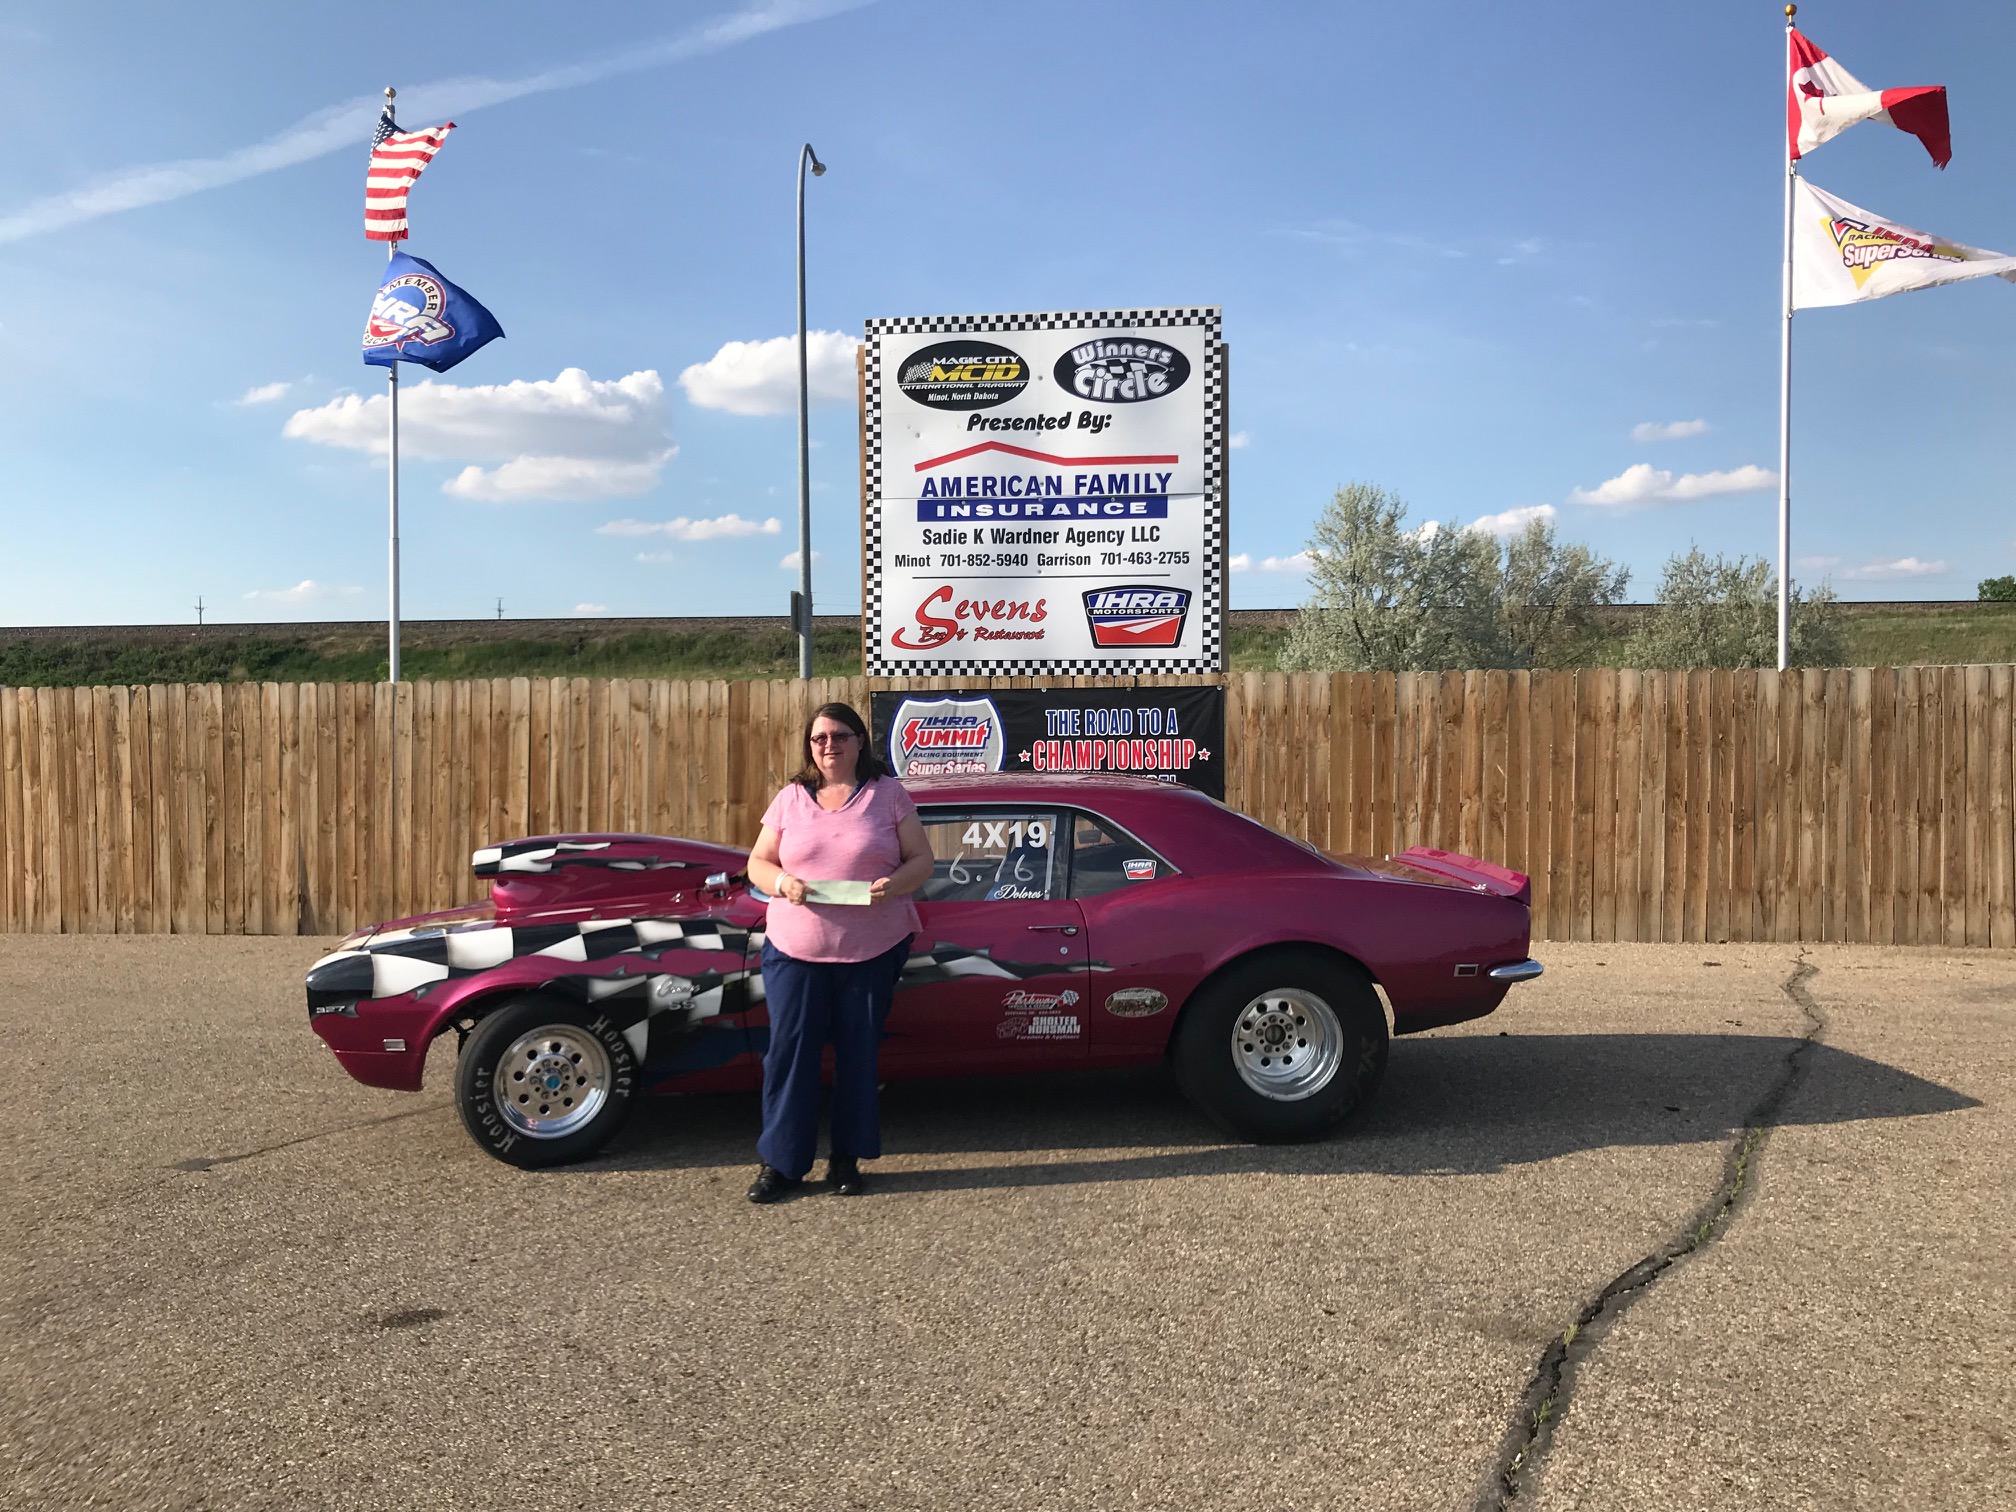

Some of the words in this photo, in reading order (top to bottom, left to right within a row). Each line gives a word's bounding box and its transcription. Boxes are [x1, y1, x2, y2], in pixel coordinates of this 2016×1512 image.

[389, 277, 438, 311] MEMBER
[932, 357, 983, 365] MAGIC
[985, 356, 1019, 365] CITY
[1071, 340, 1174, 365] Winners
[929, 364, 1021, 382] MCID
[1074, 367, 1171, 400] Circle
[901, 383, 974, 391] INTERNATIONAL
[927, 393, 949, 402] Minot,
[951, 392, 972, 401] North
[973, 392, 999, 400] Dakota
[967, 412, 1072, 432] Presented
[1077, 411, 1112, 434] By:
[921, 475, 1062, 498] AMERICAN
[1074, 473, 1173, 495] FAMILY
[936, 502, 1147, 518] INSURANCE
[922, 528, 968, 546] Sadie
[974, 528, 985, 545] K
[990, 527, 1059, 545] Wardner
[1065, 526, 1125, 546] Agency
[1131, 526, 1160, 543] LLC
[895, 554, 931, 568] Minot
[939, 554, 1028, 568] 701-852-5940
[1037, 553, 1091, 567] Garrison
[1100, 551, 1190, 566] 701-463-2755
[1095, 593, 1179, 608] IHRA
[891, 585, 1048, 650] Sevens
[973, 626, 1045, 642] Restaurant
[926, 717, 977, 726] IHRA
[1045, 709, 1080, 736] THE
[1085, 708, 1133, 736] ROAD
[1137, 708, 1161, 736] TO
[1166, 708, 1179, 735] A
[1033, 739, 1196, 771] CHAMPIONSHIP
[962, 821, 1047, 849] 4X19
[950, 852, 1034, 885] 6.76
[994, 885, 1043, 900] Dolores
[586, 1014, 632, 1098] Hoosier
[470, 1067, 521, 1153] Hoosier
